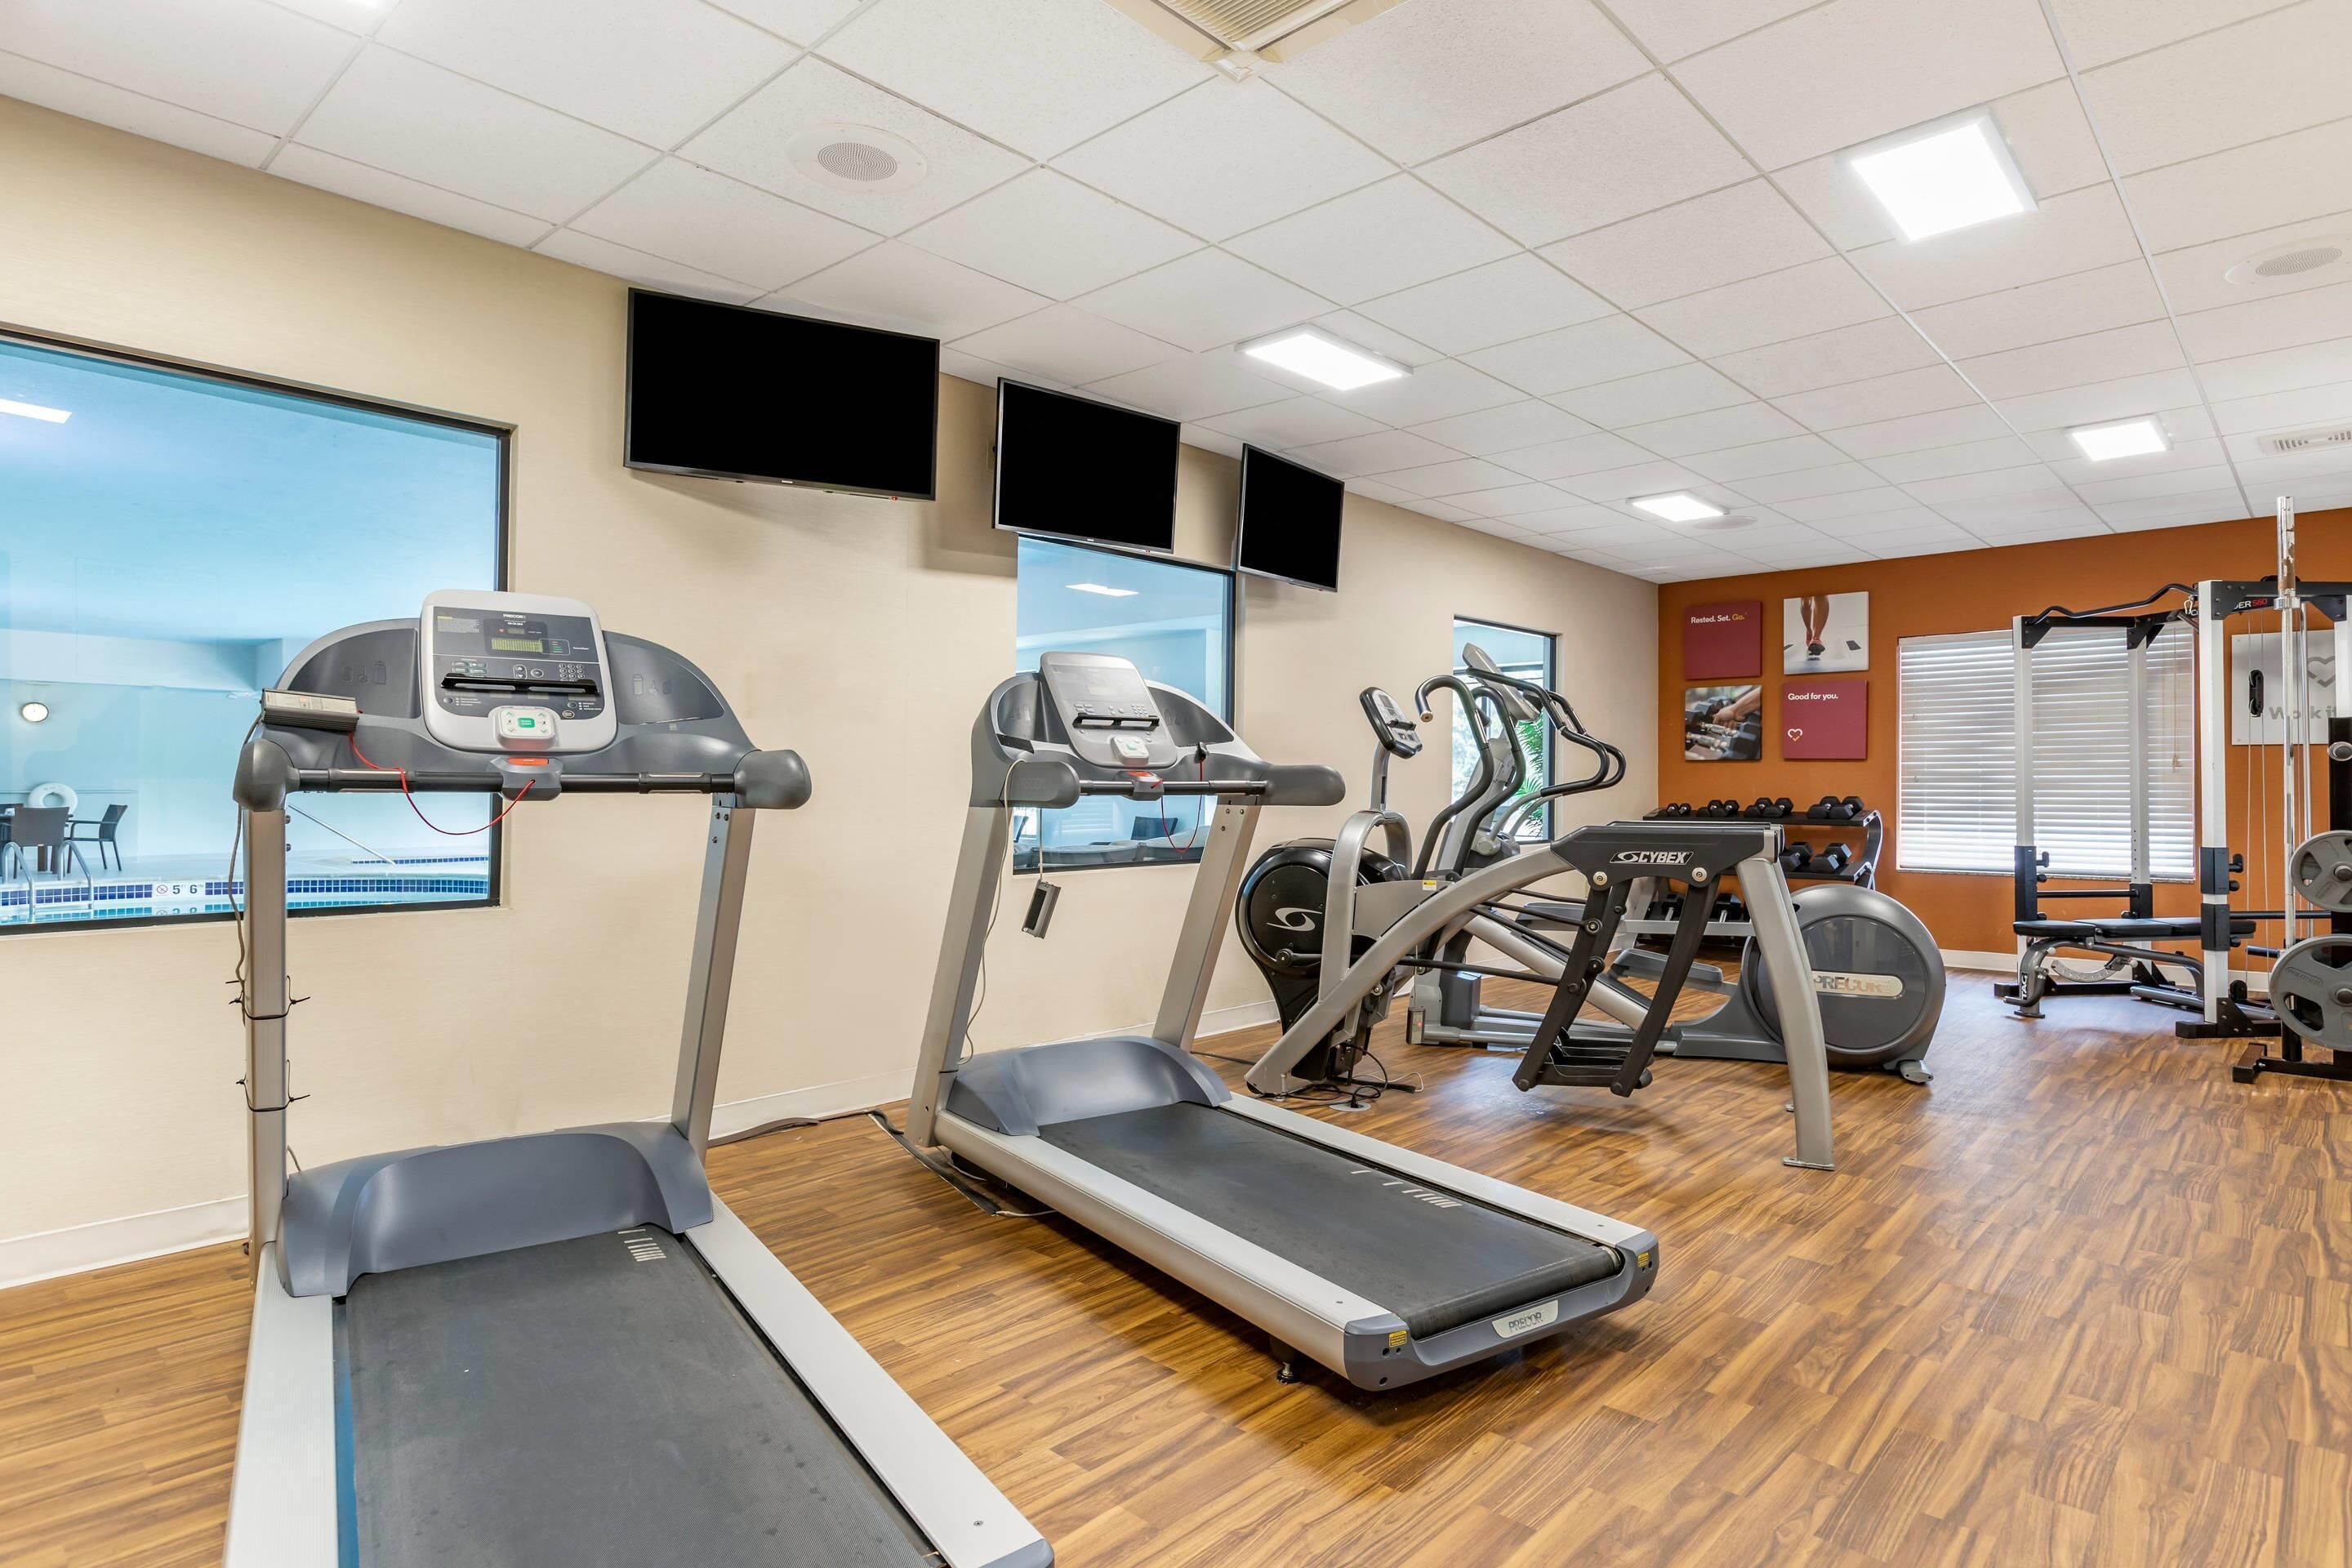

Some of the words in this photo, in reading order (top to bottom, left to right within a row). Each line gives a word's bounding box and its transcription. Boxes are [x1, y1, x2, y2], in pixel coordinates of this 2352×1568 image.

[1690, 615, 1716, 624] Rested.
[1788, 693, 1810, 701] Good
[1811, 692, 1822, 700] for
[1822, 693, 1838, 702] you.
[2269, 705, 2322, 719] Wok
[1637, 851, 1687, 864] CYBEX
[172, 884, 180, 895] 5
[189, 884, 198, 894] 6
[1508, 1312, 1544, 1333] PRECOR
